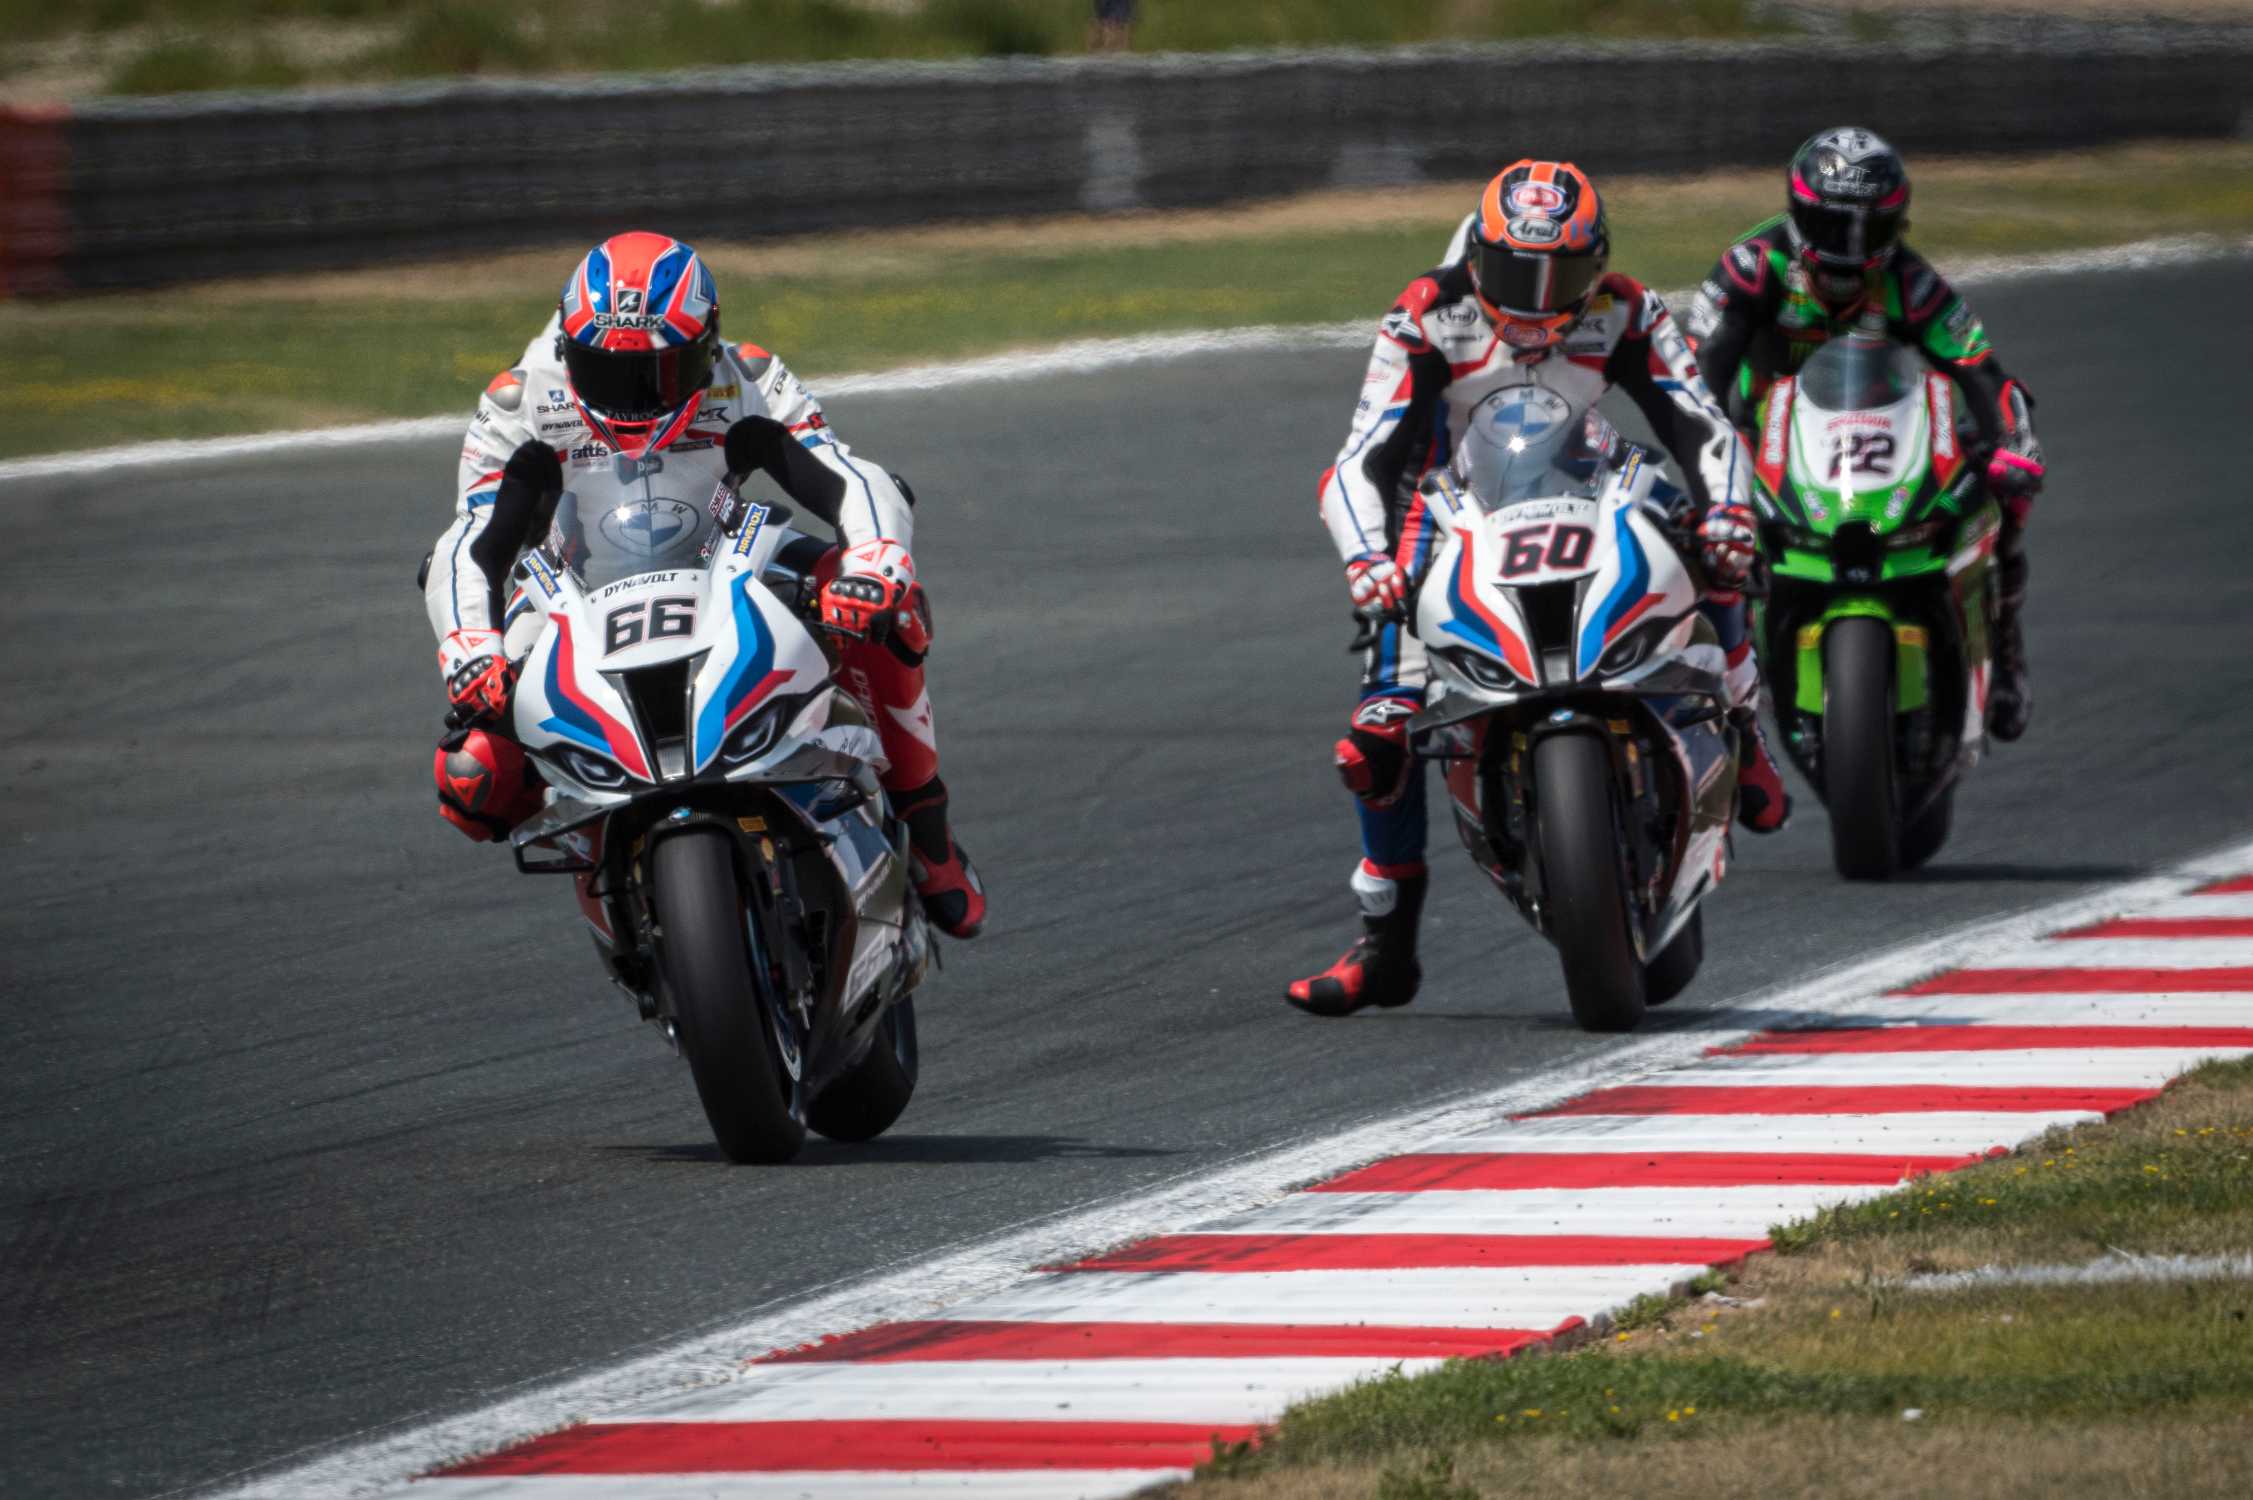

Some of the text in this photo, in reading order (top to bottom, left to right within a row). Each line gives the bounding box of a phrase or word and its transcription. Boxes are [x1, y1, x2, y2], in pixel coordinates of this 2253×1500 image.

[594, 313, 665, 329] SHARK
[535, 401, 577, 414] SHAR
[571, 444, 609, 461] attis
[1827, 431, 1896, 481] 22
[1499, 523, 1596, 580] 60
[603, 571, 679, 598] DYNAVOLT
[603, 596, 699, 657] 66
